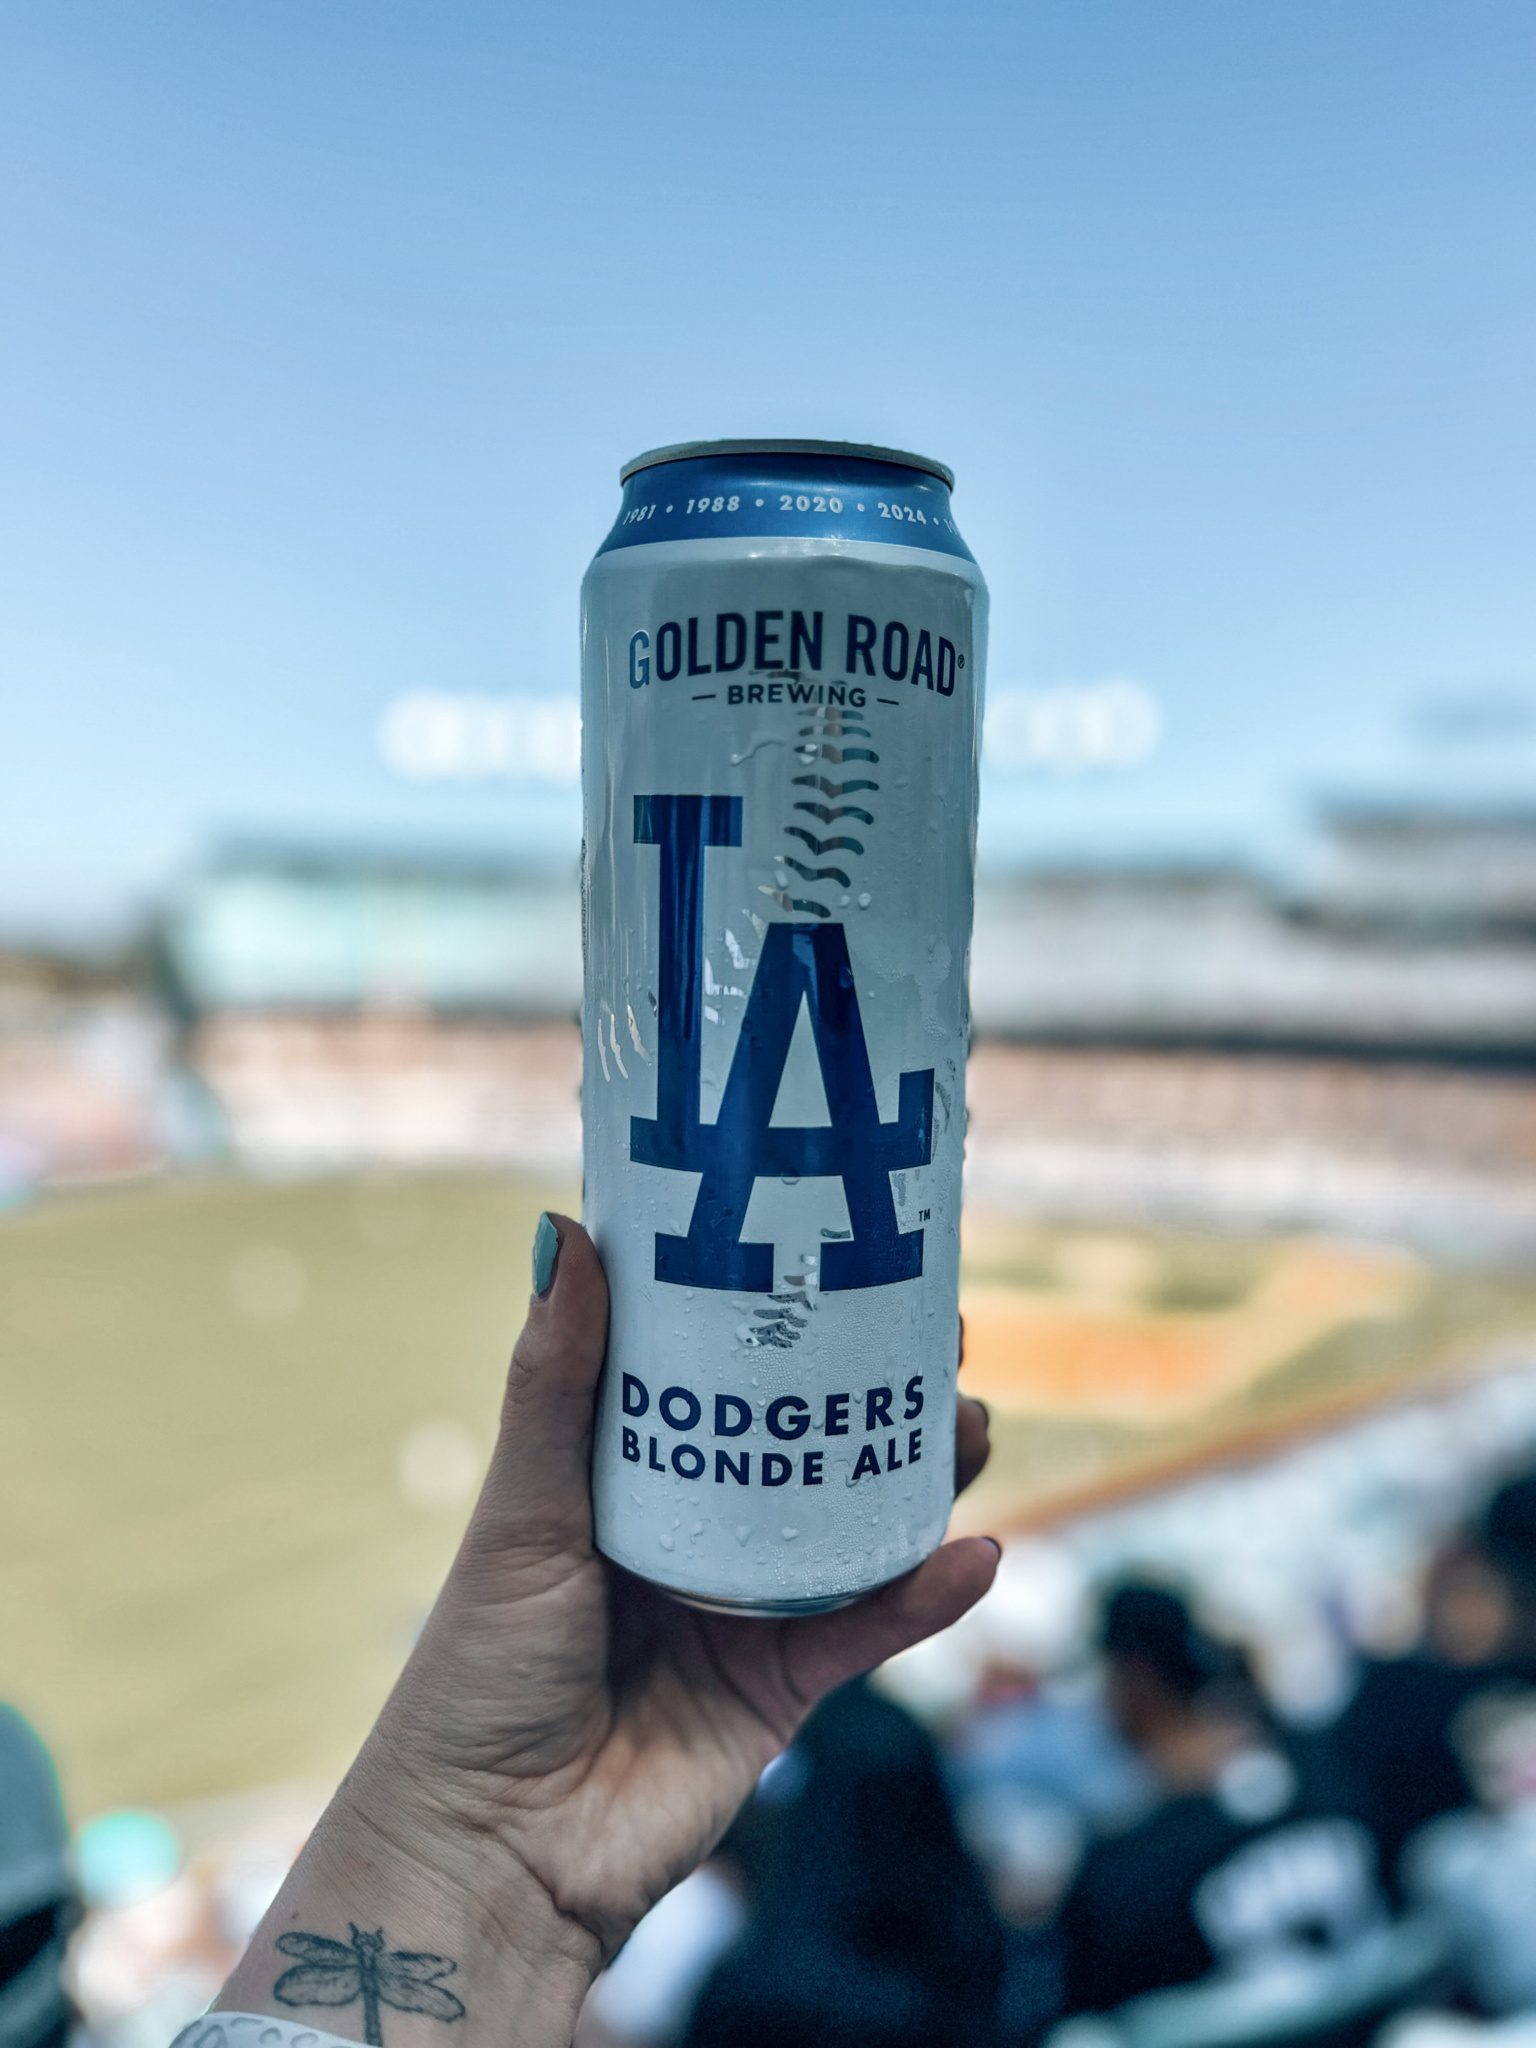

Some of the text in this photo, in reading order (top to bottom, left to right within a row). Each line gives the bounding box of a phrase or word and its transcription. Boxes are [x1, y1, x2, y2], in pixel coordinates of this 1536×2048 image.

[622, 496, 927, 526] 1981 1988 2020 2024
[629, 611, 823, 689] GOLDEN
[728, 684, 866, 708] BREWING
[622, 1372, 924, 1440] DODGERS
[622, 1426, 922, 1487] BLONDE ALE
